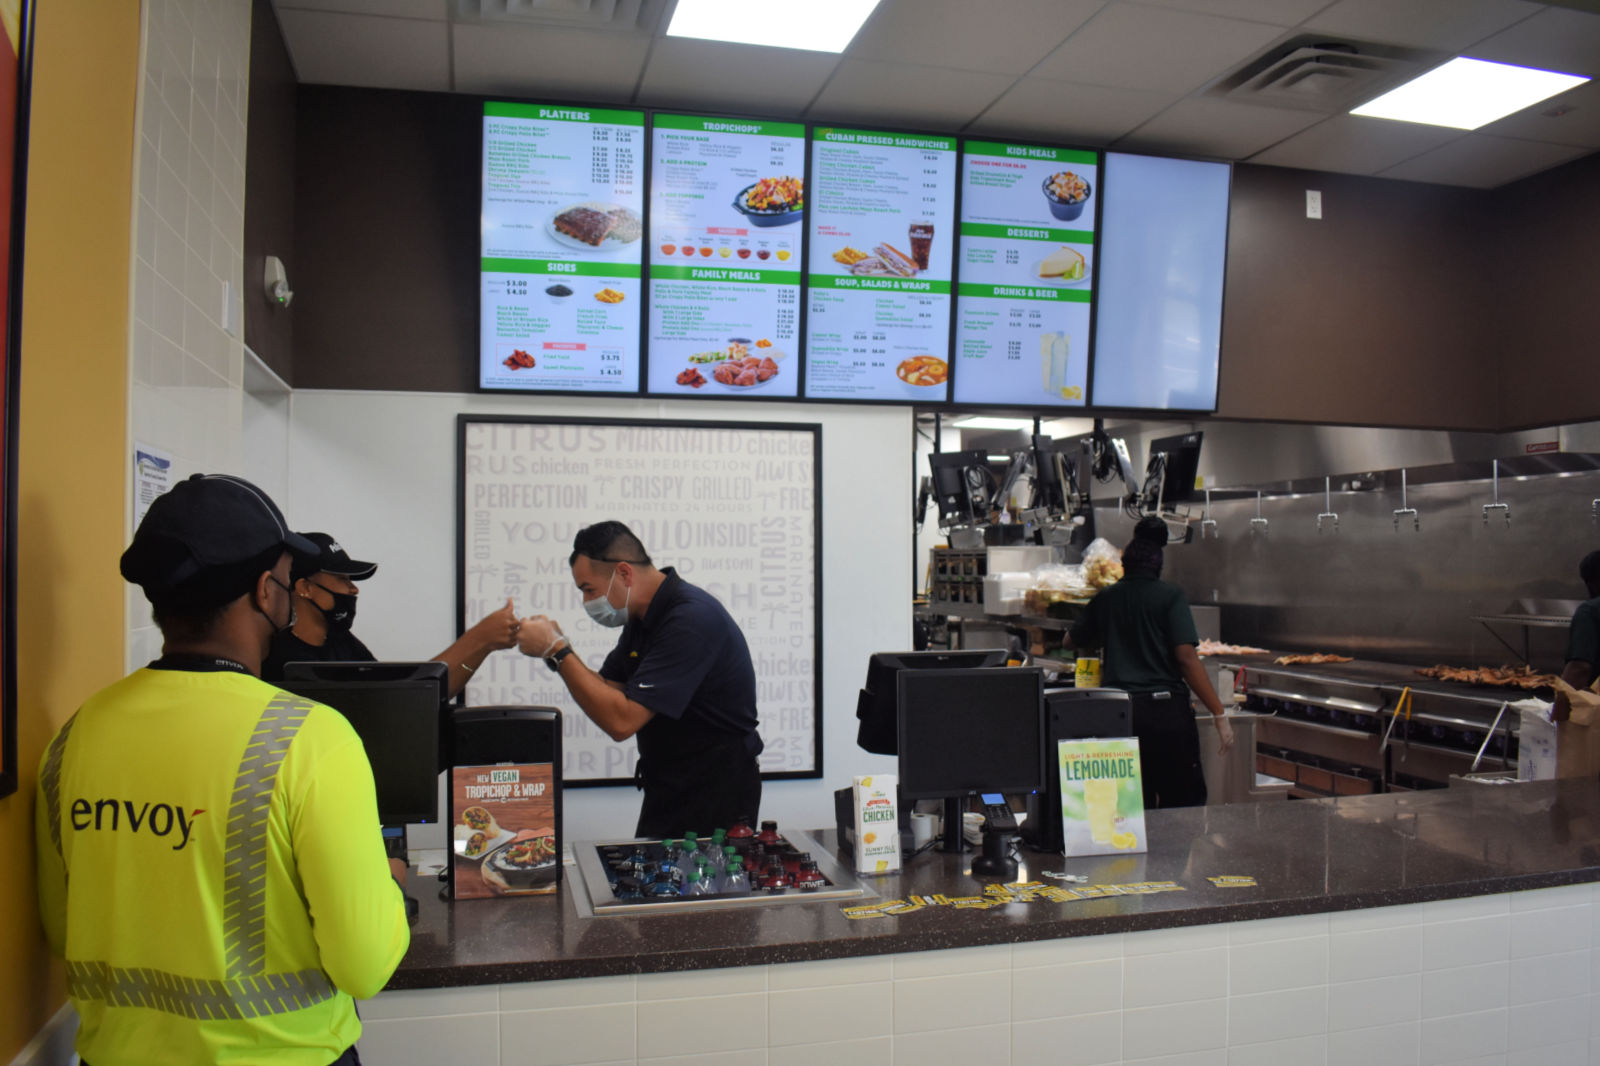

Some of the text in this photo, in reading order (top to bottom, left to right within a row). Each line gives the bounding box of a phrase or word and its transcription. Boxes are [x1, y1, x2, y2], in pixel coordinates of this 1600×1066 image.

[539, 109, 590, 121] PLATTERS
[826, 133, 949, 149] CUBAN PRESSED SANDWICHES
[1006, 146, 1057, 159] KIDS MEALS
[1007, 228, 1049, 239] DESSERTS
[547, 262, 577, 272] SIDES
[692, 269, 760, 281] FAMILY MEALS
[835, 278, 930, 290] SOUP, SALADS & WRAPS
[994, 287, 1026, 297] DRINKS
[1036, 289, 1058, 298] BEER
[615, 427, 742, 454] MARINATED
[531, 455, 590, 475] chicken
[594, 458, 751, 472] FRESH PERFECTION
[621, 475, 685, 499] CRISPY
[692, 476, 752, 501] GRILLED
[474, 483, 588, 509] PERFECTION
[594, 502, 679, 513] MARINATED
[706, 502, 752, 513] HOURS
[474, 510, 491, 560] GRILLED
[501, 521, 758, 549] YOU INSIDE
[761, 516, 786, 598] CITRUS
[790, 515, 804, 648] MARINATED
[477, 771, 517, 783] NEW VEGAN
[1066, 758, 1135, 781] LEMONADE
[465, 783, 546, 799] TROPICHOP & WRAP
[863, 809, 895, 823] CHICKEN
[71, 798, 194, 851] envoy
